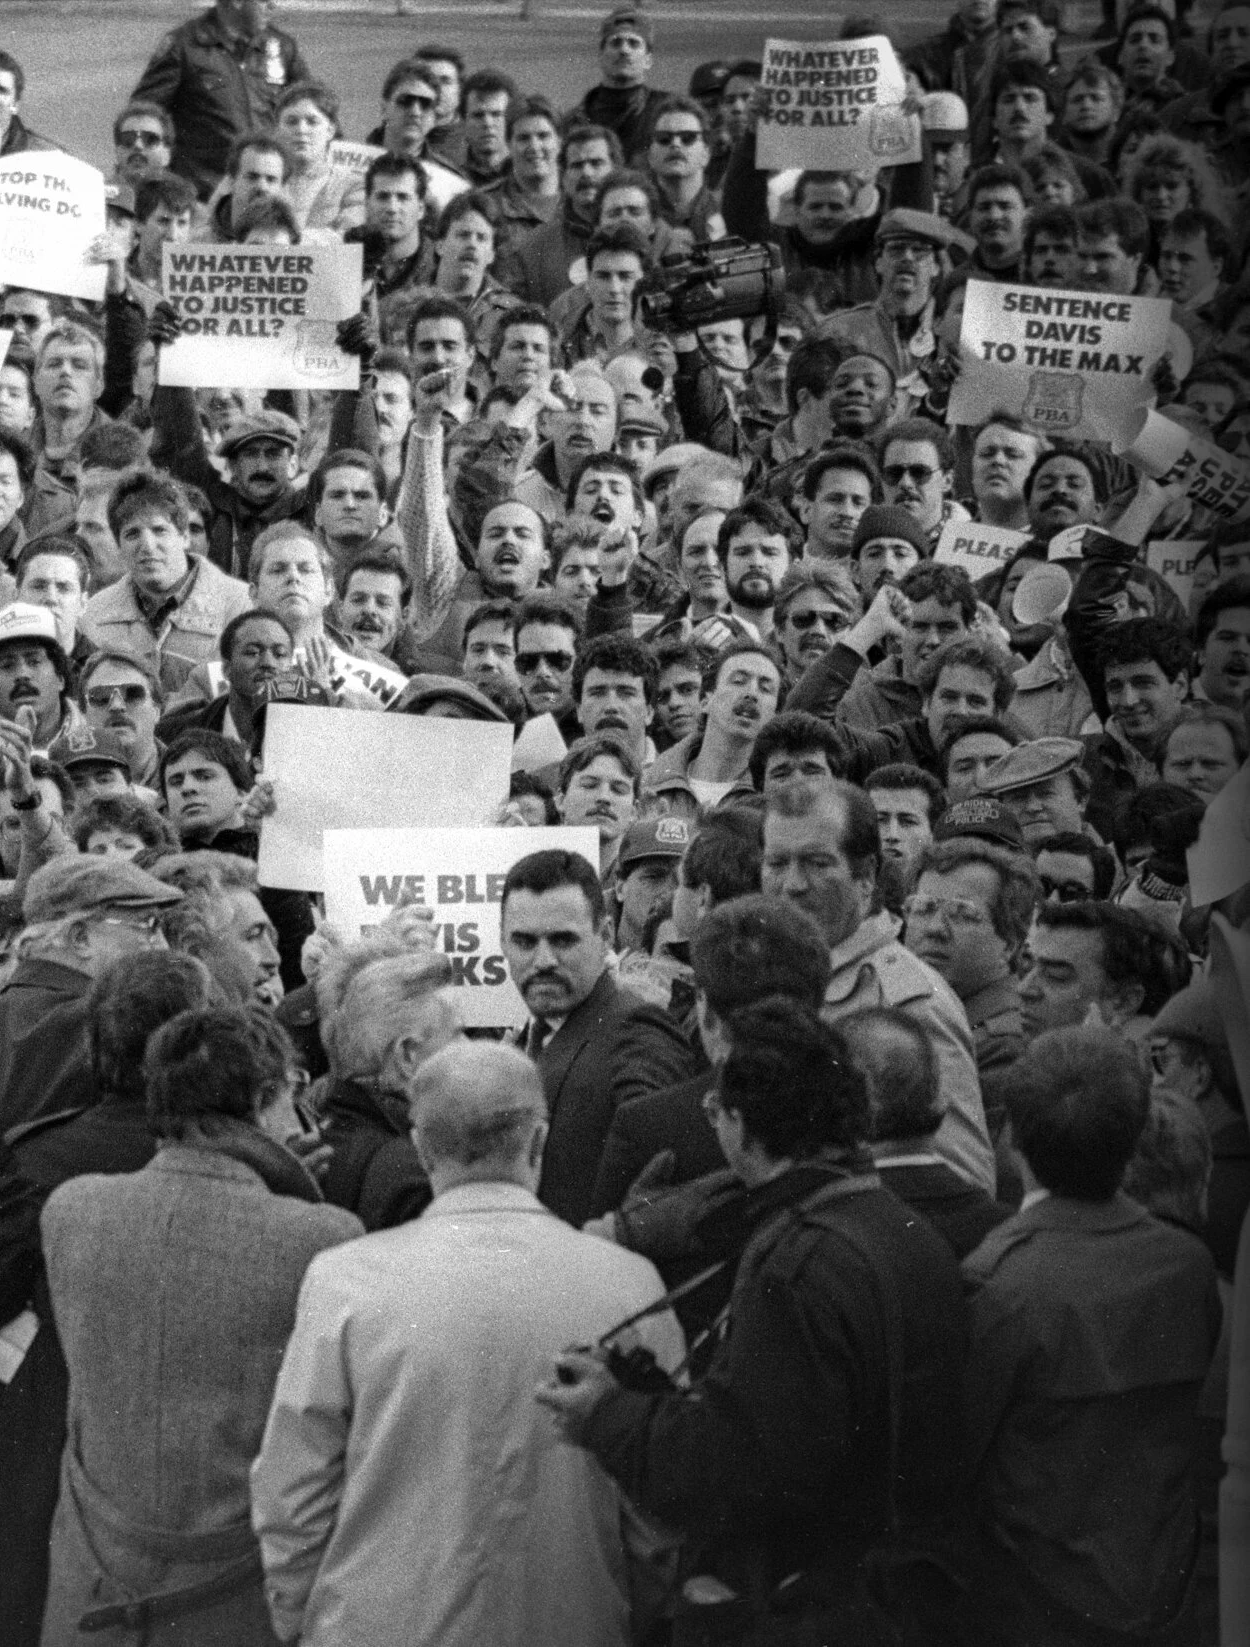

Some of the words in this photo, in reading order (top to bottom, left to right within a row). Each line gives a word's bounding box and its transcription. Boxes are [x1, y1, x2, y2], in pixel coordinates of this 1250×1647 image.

[769, 48, 879, 68] WHATEVER
[766, 67, 877, 87] HAPPENED
[764, 88, 791, 105] TO
[797, 86, 876, 106] JUSTICE
[774, 108, 804, 125] OR
[810, 108, 860, 126] ALL?
[42, 174, 72, 192] TH
[170, 254, 314, 274] WHATEVER
[169, 274, 308, 294] HAPPENED
[170, 295, 204, 315] TO
[210, 295, 306, 316] JUSTICE
[1002, 292, 1132, 323] SENTENCE
[180, 317, 220, 336] OR
[225, 318, 285, 338] ALL?
[1024, 320, 1102, 346] DAVIS
[304, 356, 340, 370] PBA
[982, 341, 1017, 363] TO
[1024, 346, 1072, 369] THE
[1076, 352, 1145, 375] MAX
[1033, 407, 1070, 423] PBA
[358, 875, 426, 905] WE
